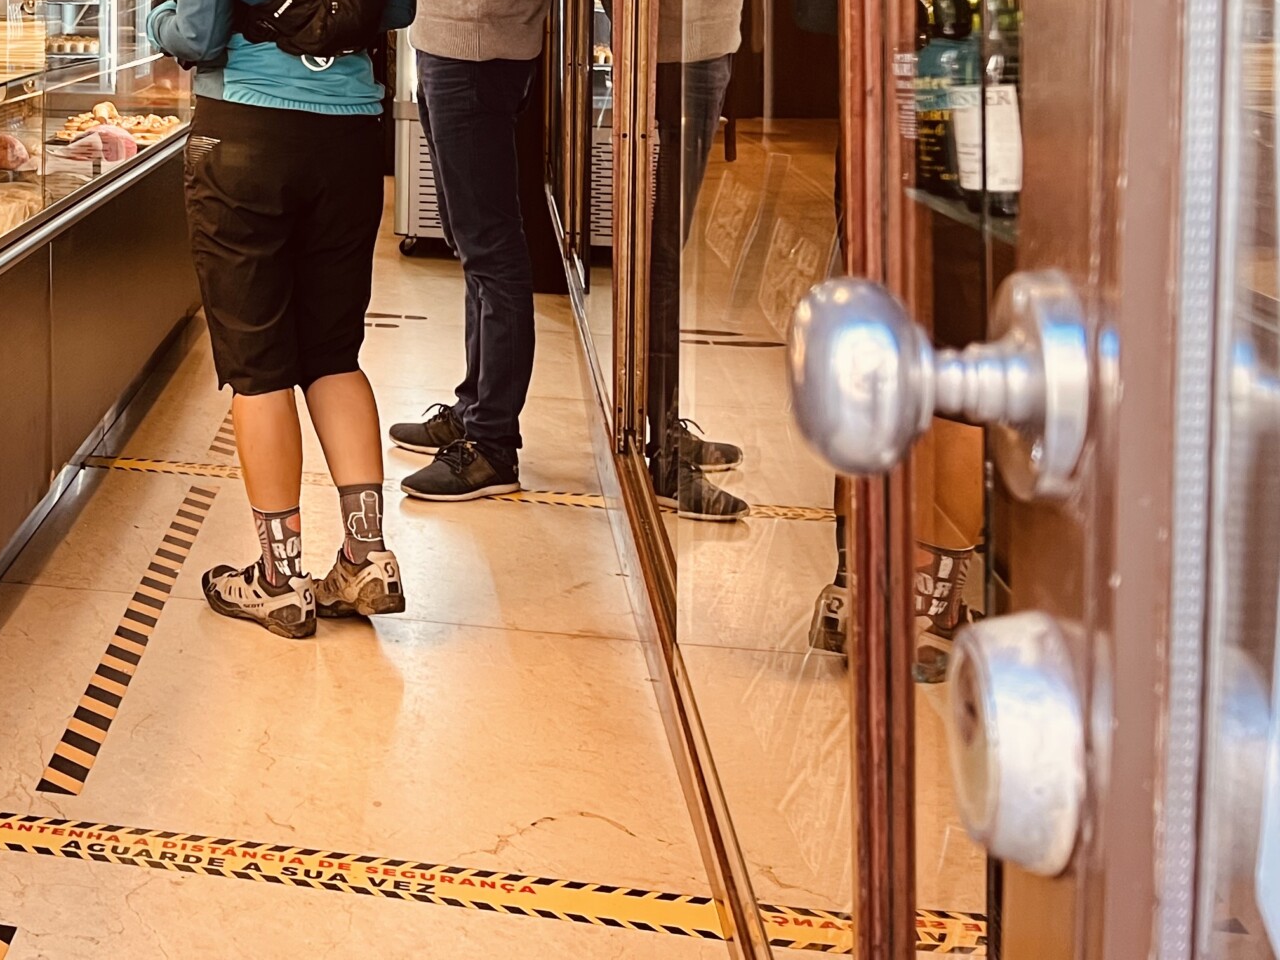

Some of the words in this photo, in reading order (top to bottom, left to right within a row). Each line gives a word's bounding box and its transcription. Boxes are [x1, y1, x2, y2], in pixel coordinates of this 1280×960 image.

[62, 840, 226, 868] AGUARDE
[241, 861, 263, 873] A
[281, 866, 350, 884] SUA
[366, 876, 436, 895] VEZ
[132, 837, 149, 847] A
[162, 840, 305, 866] DISTÂNCIA
[318, 859, 352, 872] DE
[365, 865, 537, 895] SEGURANÇA
